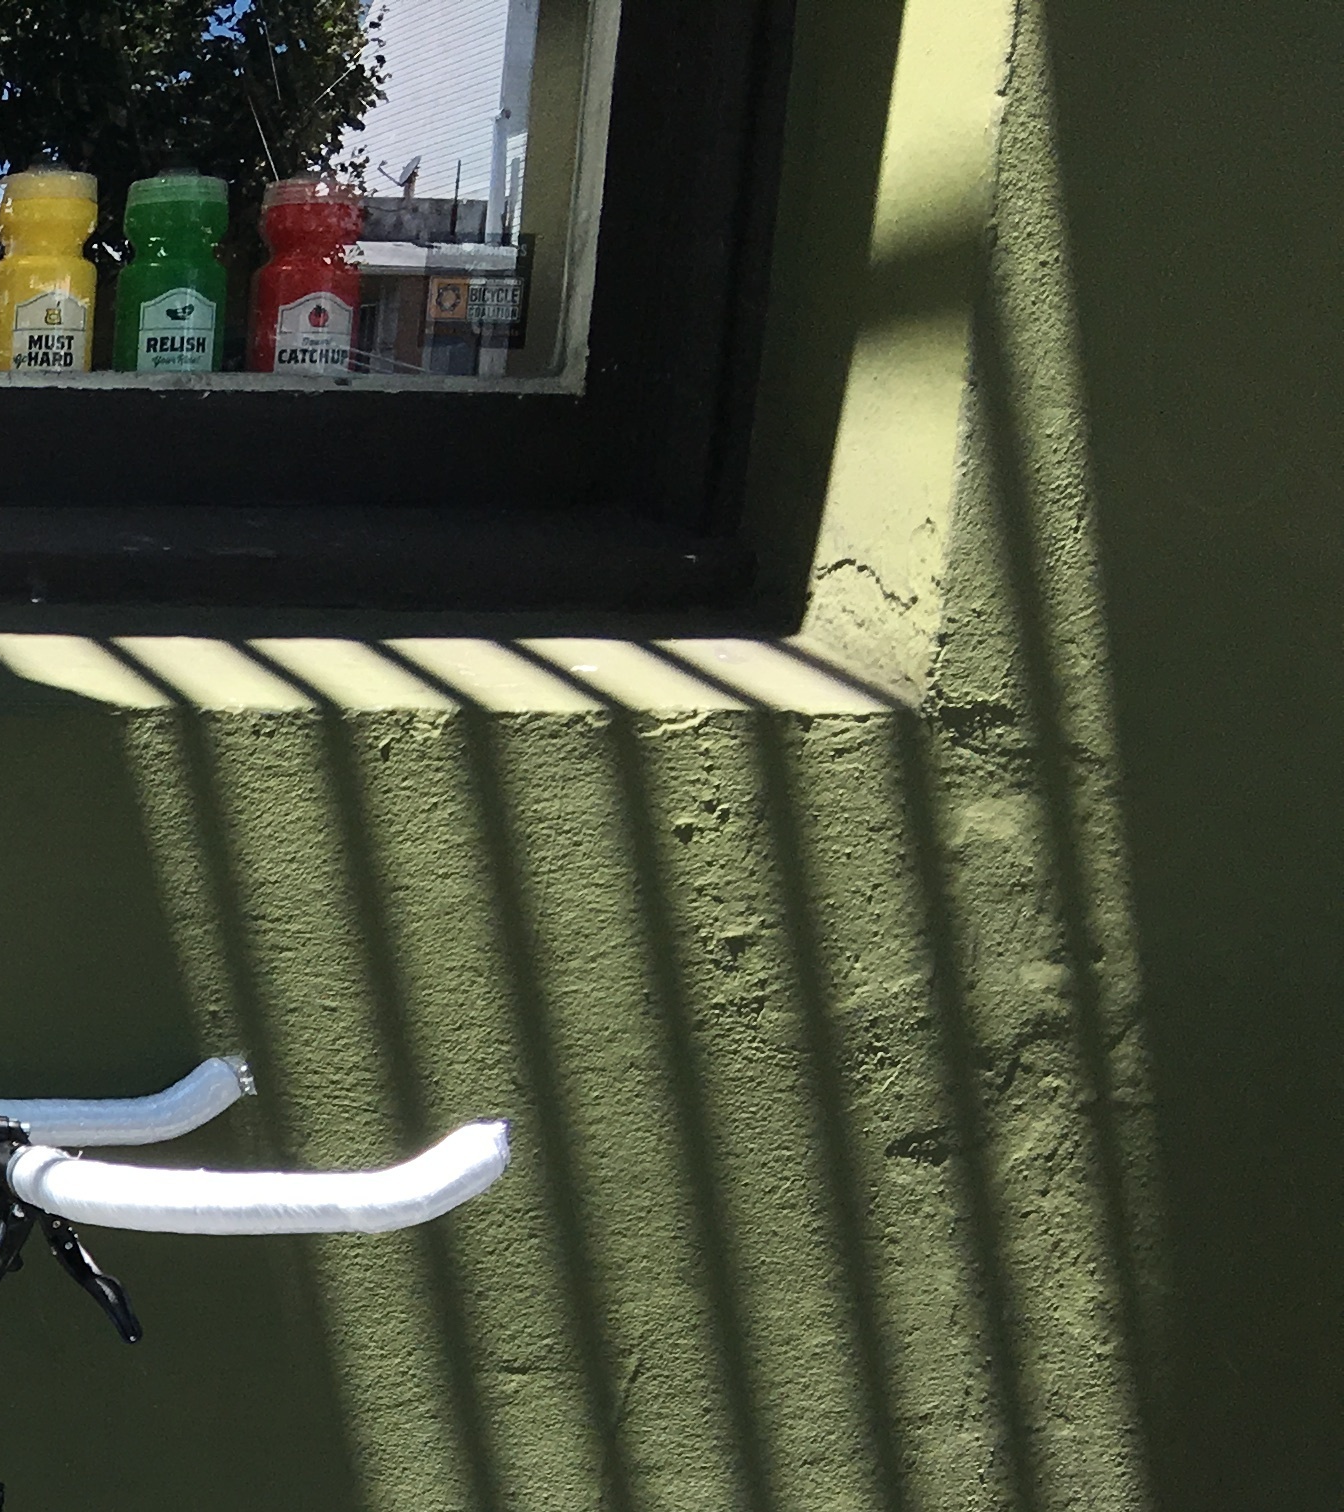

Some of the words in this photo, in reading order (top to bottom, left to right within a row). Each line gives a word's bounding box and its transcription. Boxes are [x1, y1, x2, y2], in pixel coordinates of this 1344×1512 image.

[469, 286, 518, 304] BICYCLE
[28, 335, 74, 351] MUST
[146, 337, 206, 353] RELISH
[27, 352, 74, 367] HARD
[277, 348, 349, 364] CATCHUP
